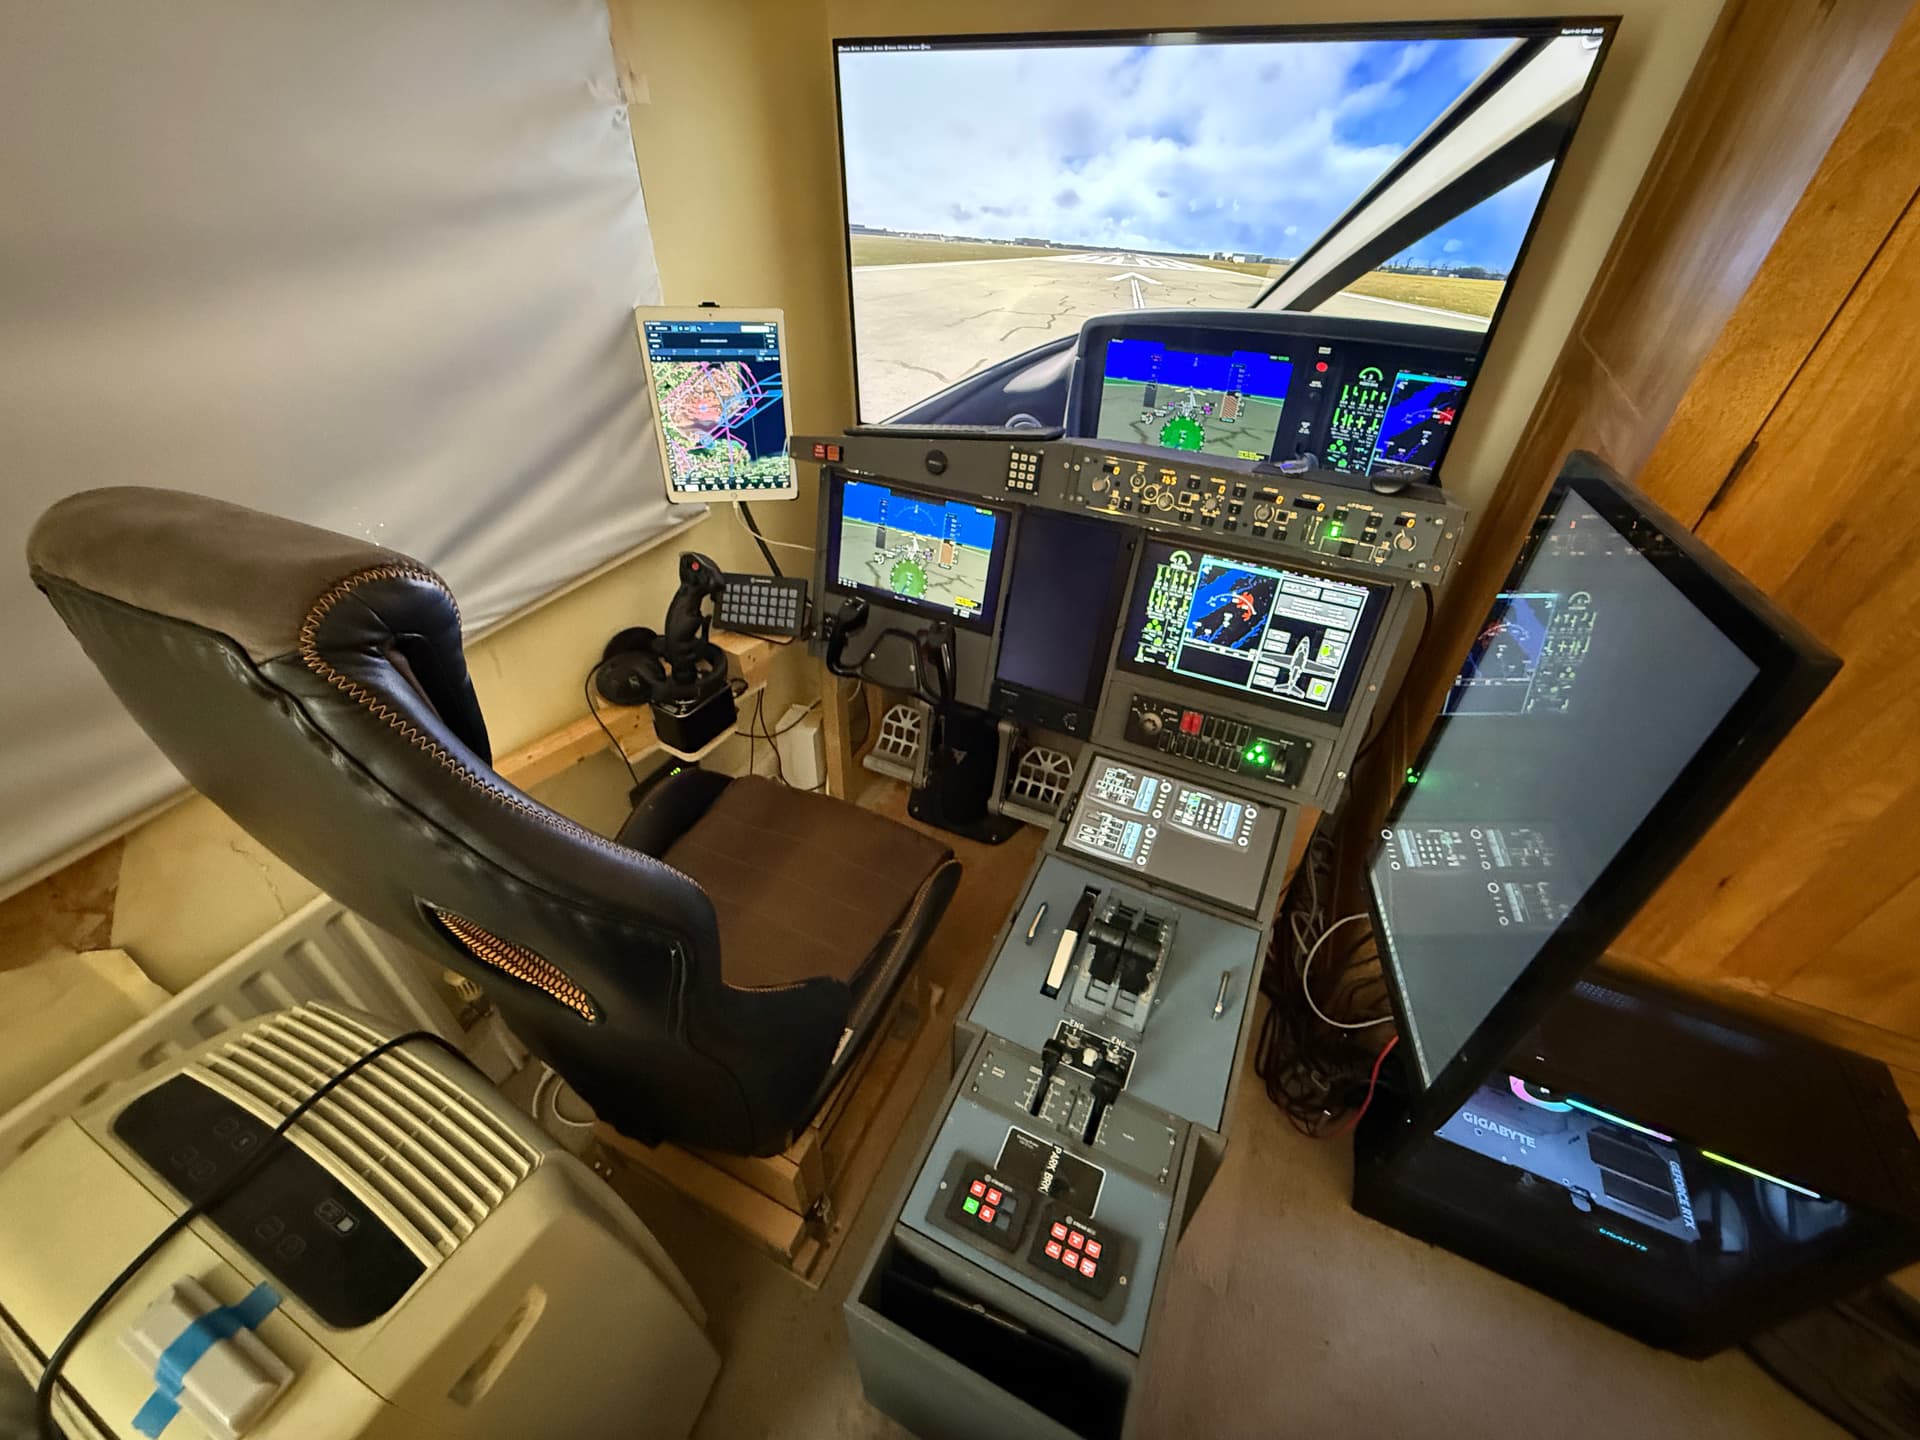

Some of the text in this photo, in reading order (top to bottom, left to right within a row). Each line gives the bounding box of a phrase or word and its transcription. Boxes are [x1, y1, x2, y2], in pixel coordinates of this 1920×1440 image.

[1275, 495, 1284, 505] 0
[1317, 503, 1325, 512] 0
[1406, 518, 1415, 528] 0
[1112, 1045, 1120, 1054] 2
[1462, 1111, 1536, 1149] GIGABYTE
[1039, 1145, 1063, 1193] PARK BRK
[1669, 1160, 1696, 1230] GEFORCE RTX
